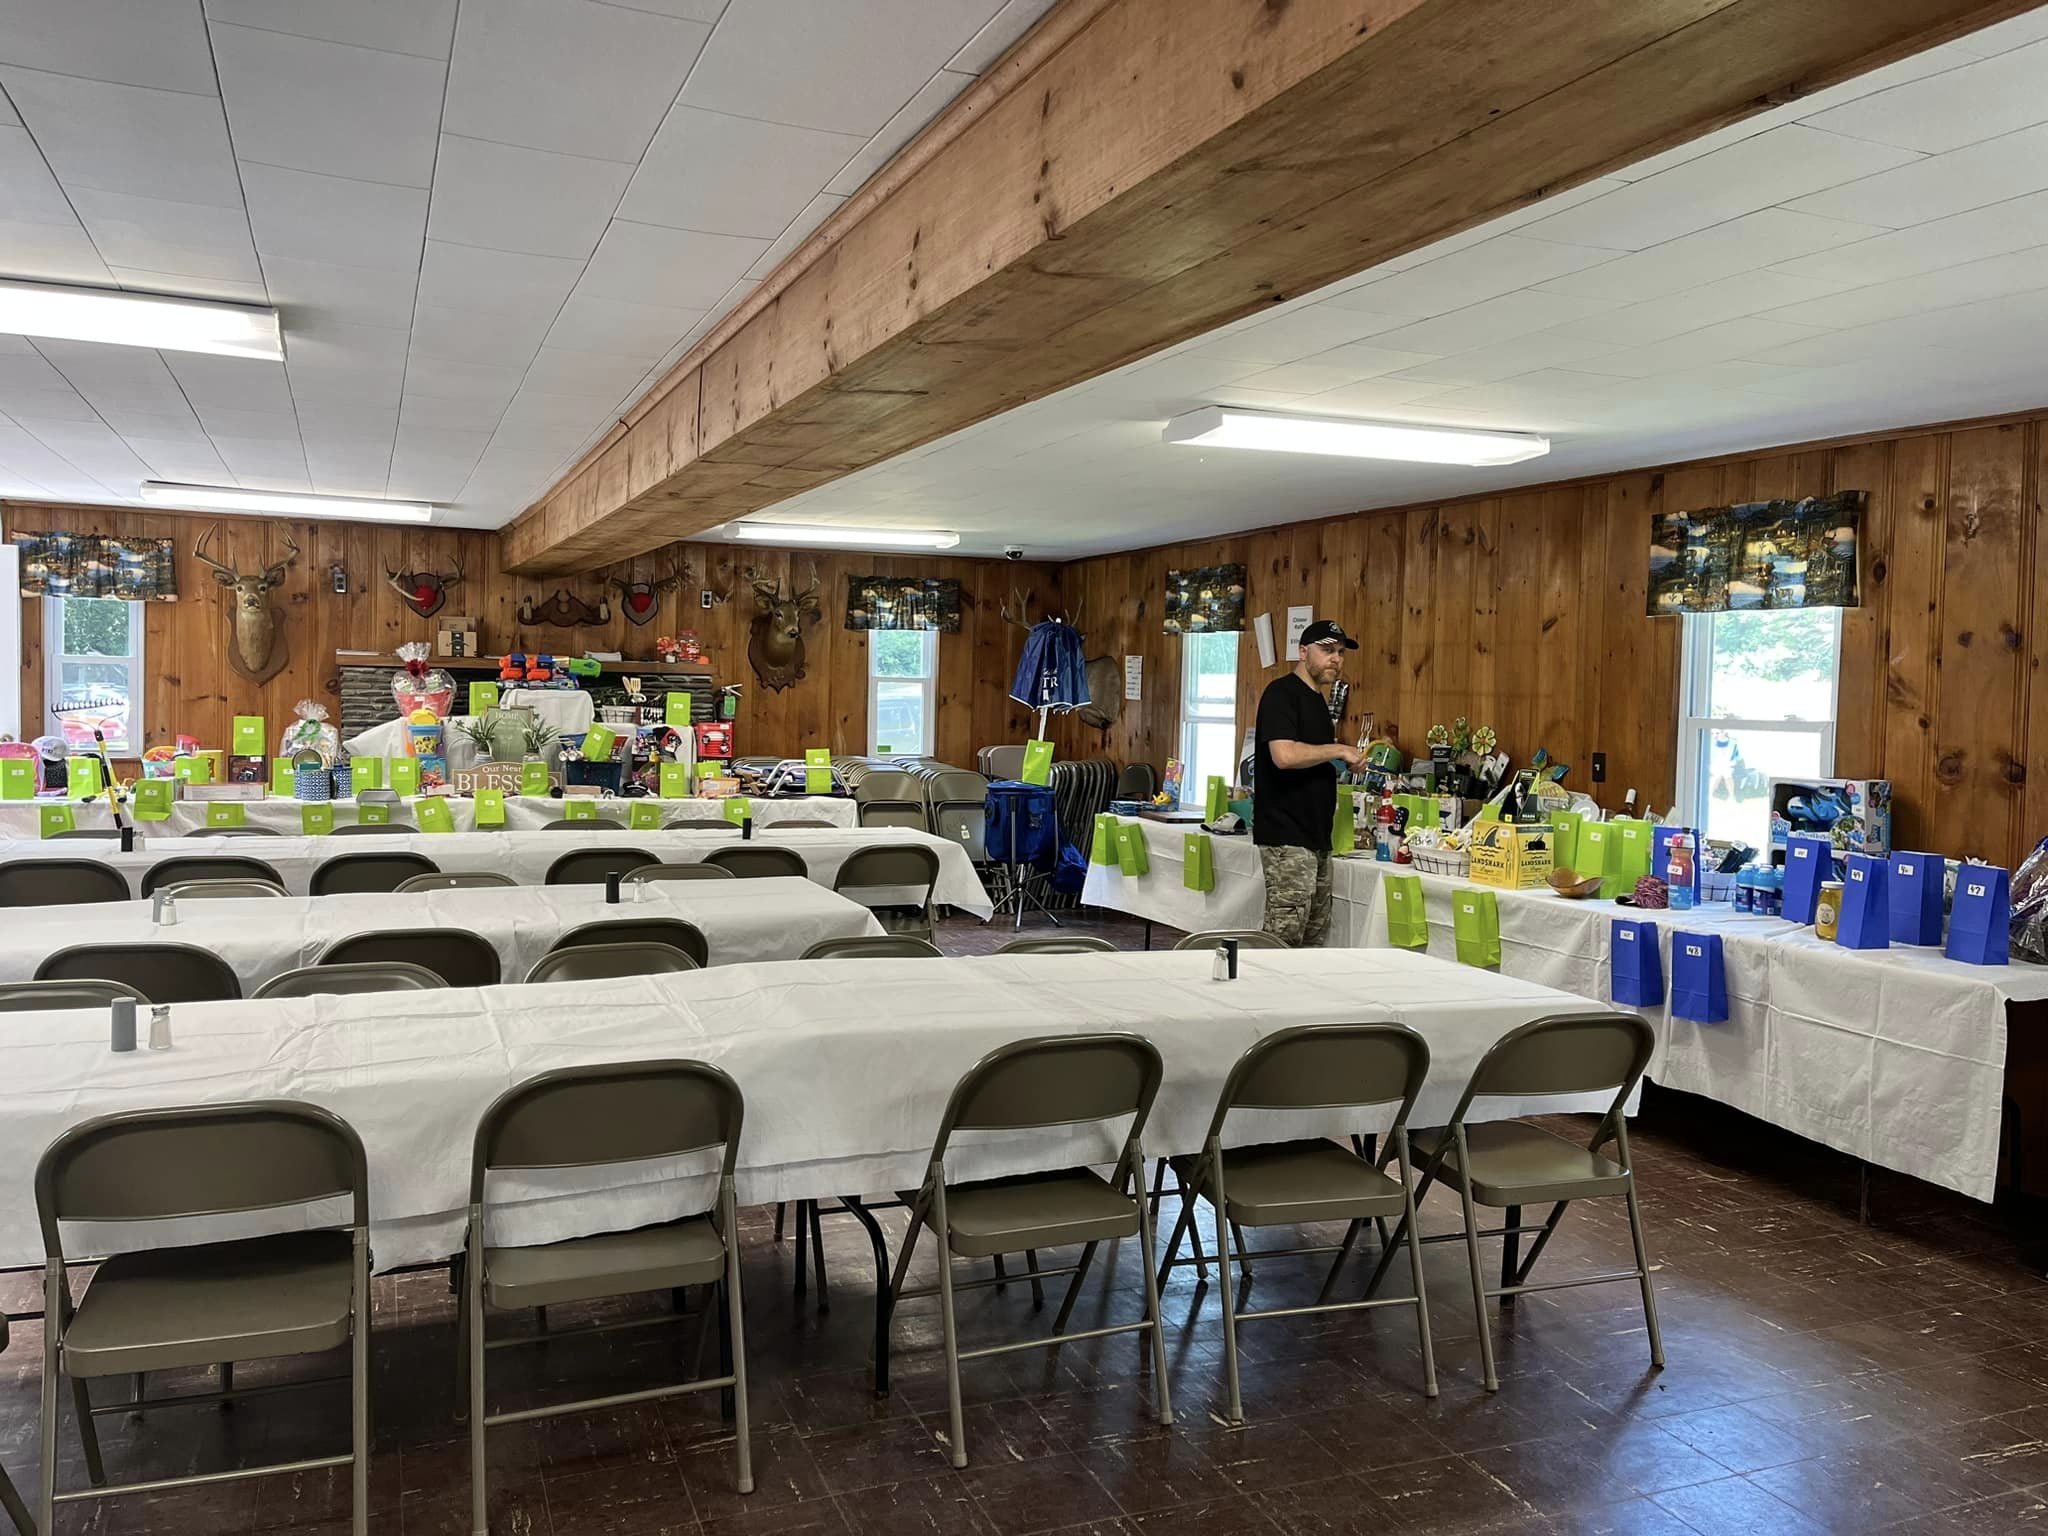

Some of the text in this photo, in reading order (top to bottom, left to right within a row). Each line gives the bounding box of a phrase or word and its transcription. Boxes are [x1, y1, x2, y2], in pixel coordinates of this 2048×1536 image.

[482, 765, 500, 773] Our
[457, 774, 558, 791] BLESS
[1471, 855, 1505, 868] LANDSHARK
[1521, 859, 1552, 867] LANDSHARK
[1688, 947, 1699, 955] 48
